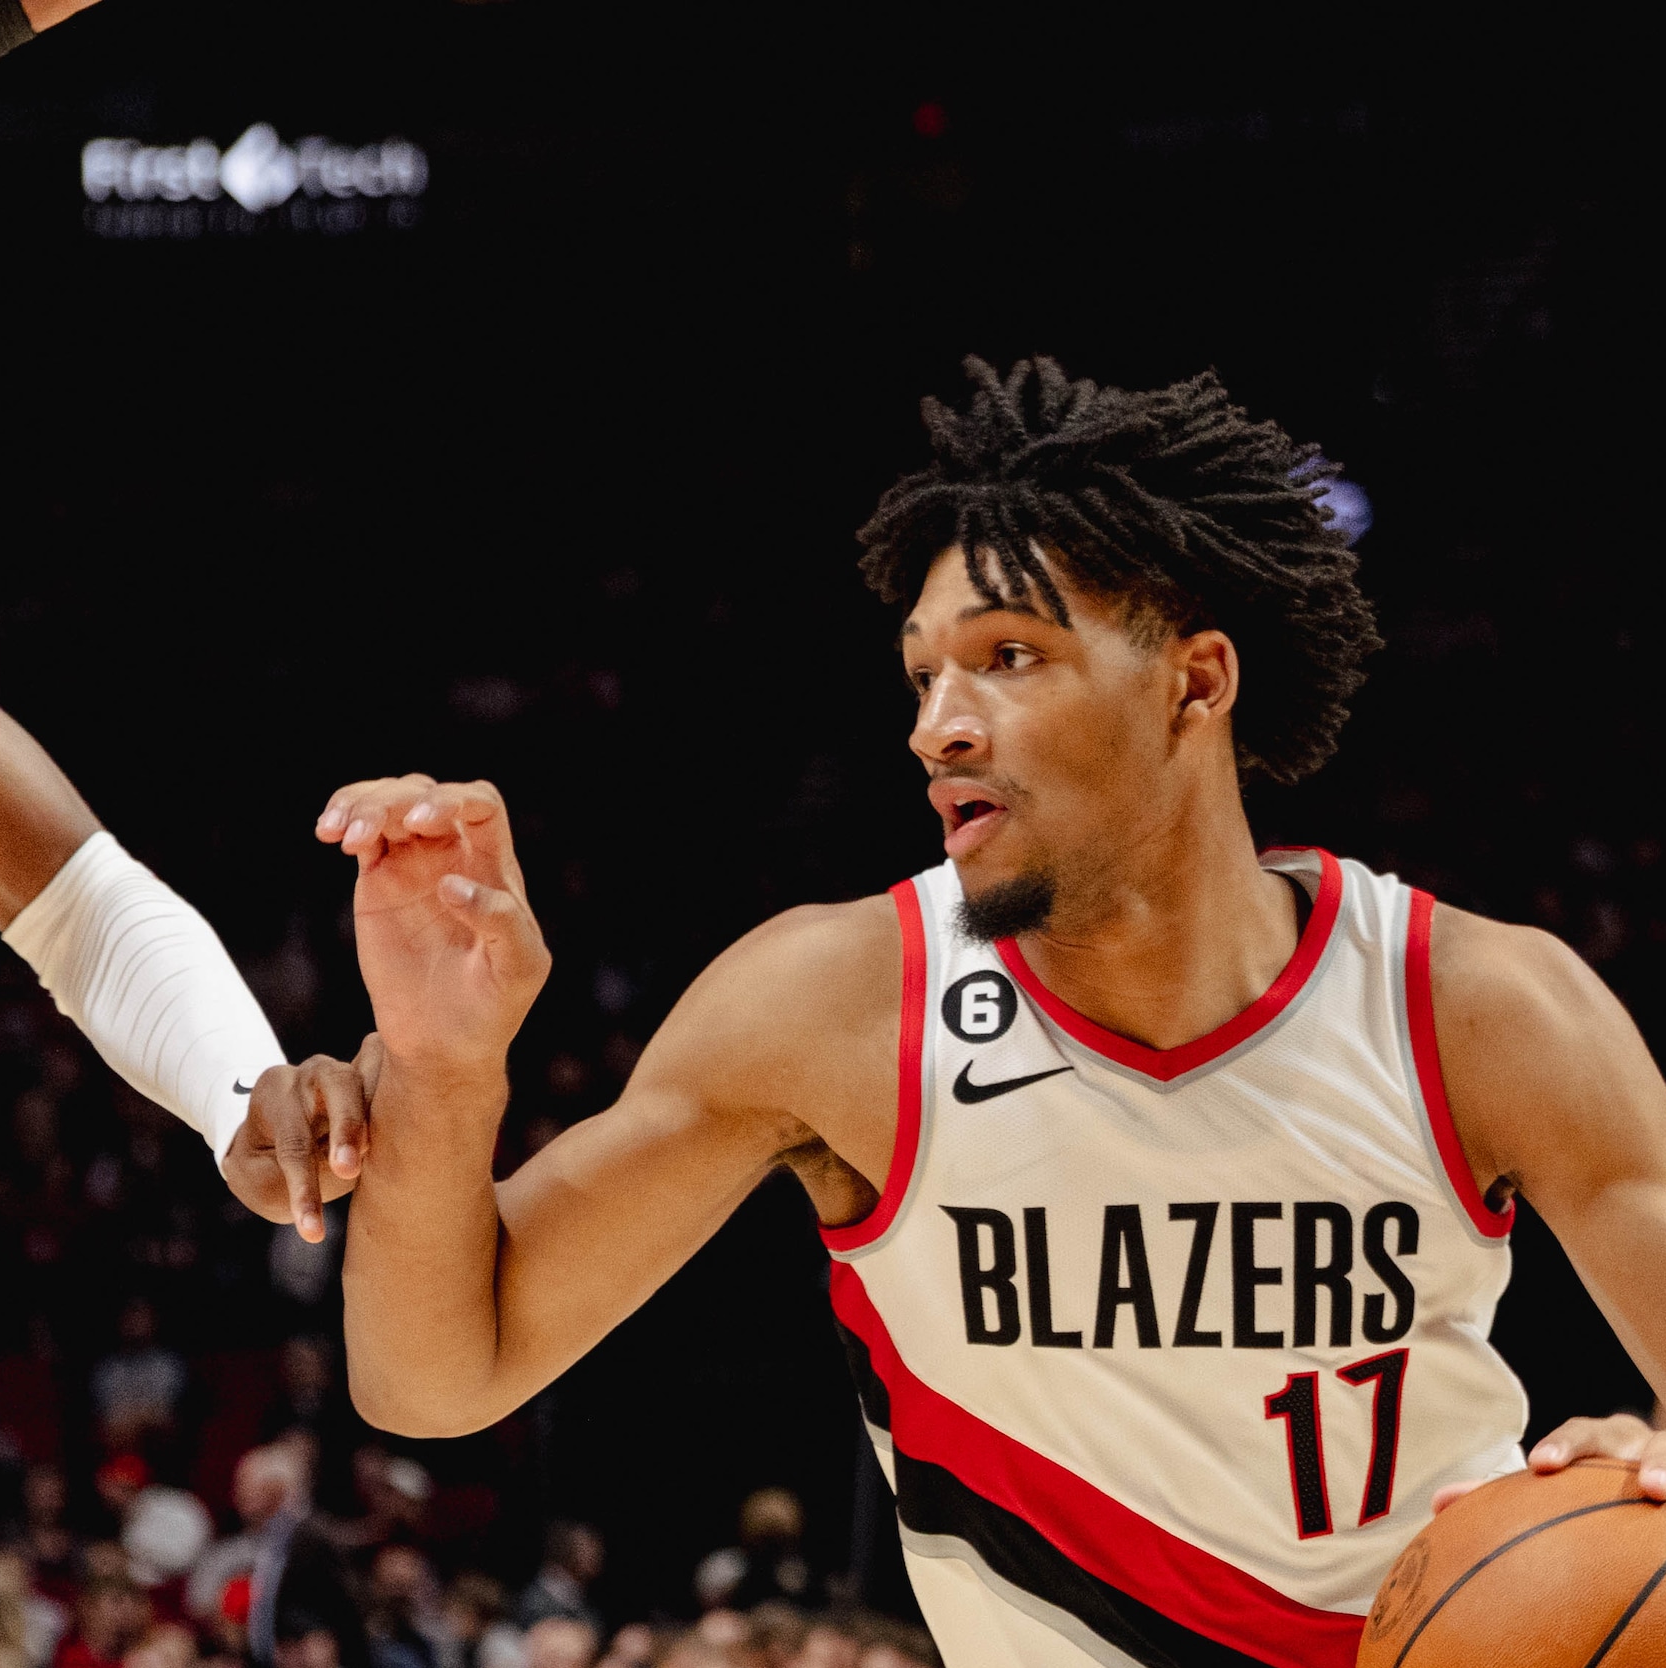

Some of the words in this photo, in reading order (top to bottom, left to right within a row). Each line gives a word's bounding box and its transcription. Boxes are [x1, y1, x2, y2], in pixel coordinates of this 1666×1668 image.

[959, 980, 1001, 1035] 6
[937, 1201, 1420, 1349] BLAZERS
[1264, 1347, 1410, 1540] 17
